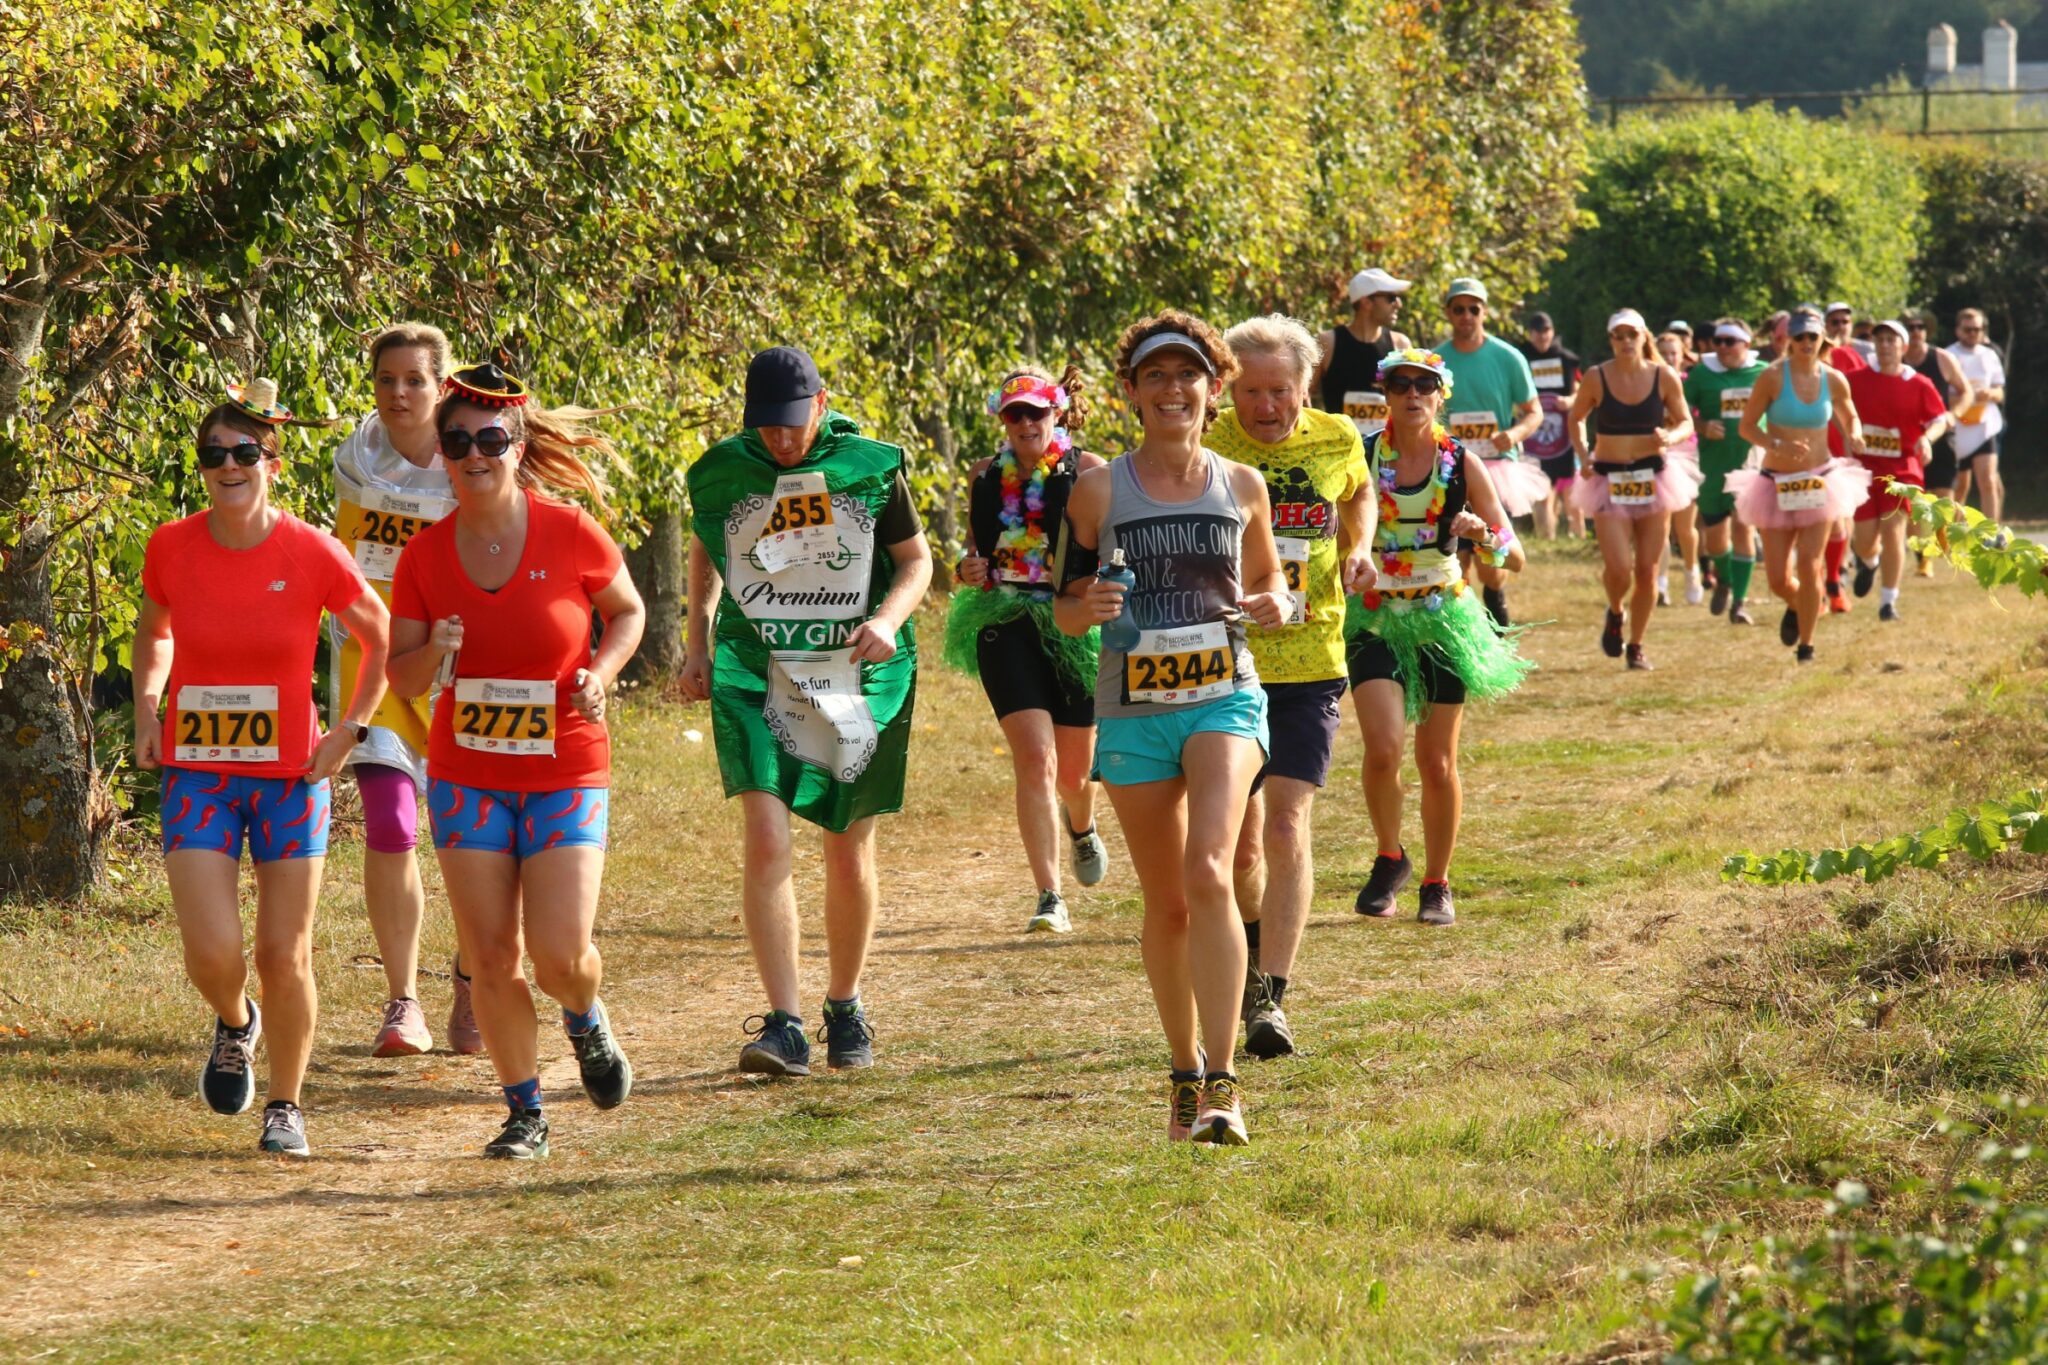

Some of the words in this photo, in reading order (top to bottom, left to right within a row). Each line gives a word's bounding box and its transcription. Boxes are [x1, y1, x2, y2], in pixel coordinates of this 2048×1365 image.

[1350, 404, 1387, 419] 3679
[1455, 423, 1495, 439] 3677
[761, 496, 826, 537] 855
[1121, 522, 1207, 561] RUNNING
[1210, 523, 1232, 557] ON
[817, 551, 835, 559] 2855
[1161, 558, 1176, 588] &
[738, 581, 860, 606] Premium
[805, 623, 855, 645] GIN
[1190, 633, 1203, 641] WINE
[1136, 650, 1227, 689] 2344
[809, 677, 831, 691] fun
[461, 703, 548, 738] 2775
[797, 713, 805, 721] cl
[182, 712, 272, 746] 2170
[851, 736, 861, 745] vol
